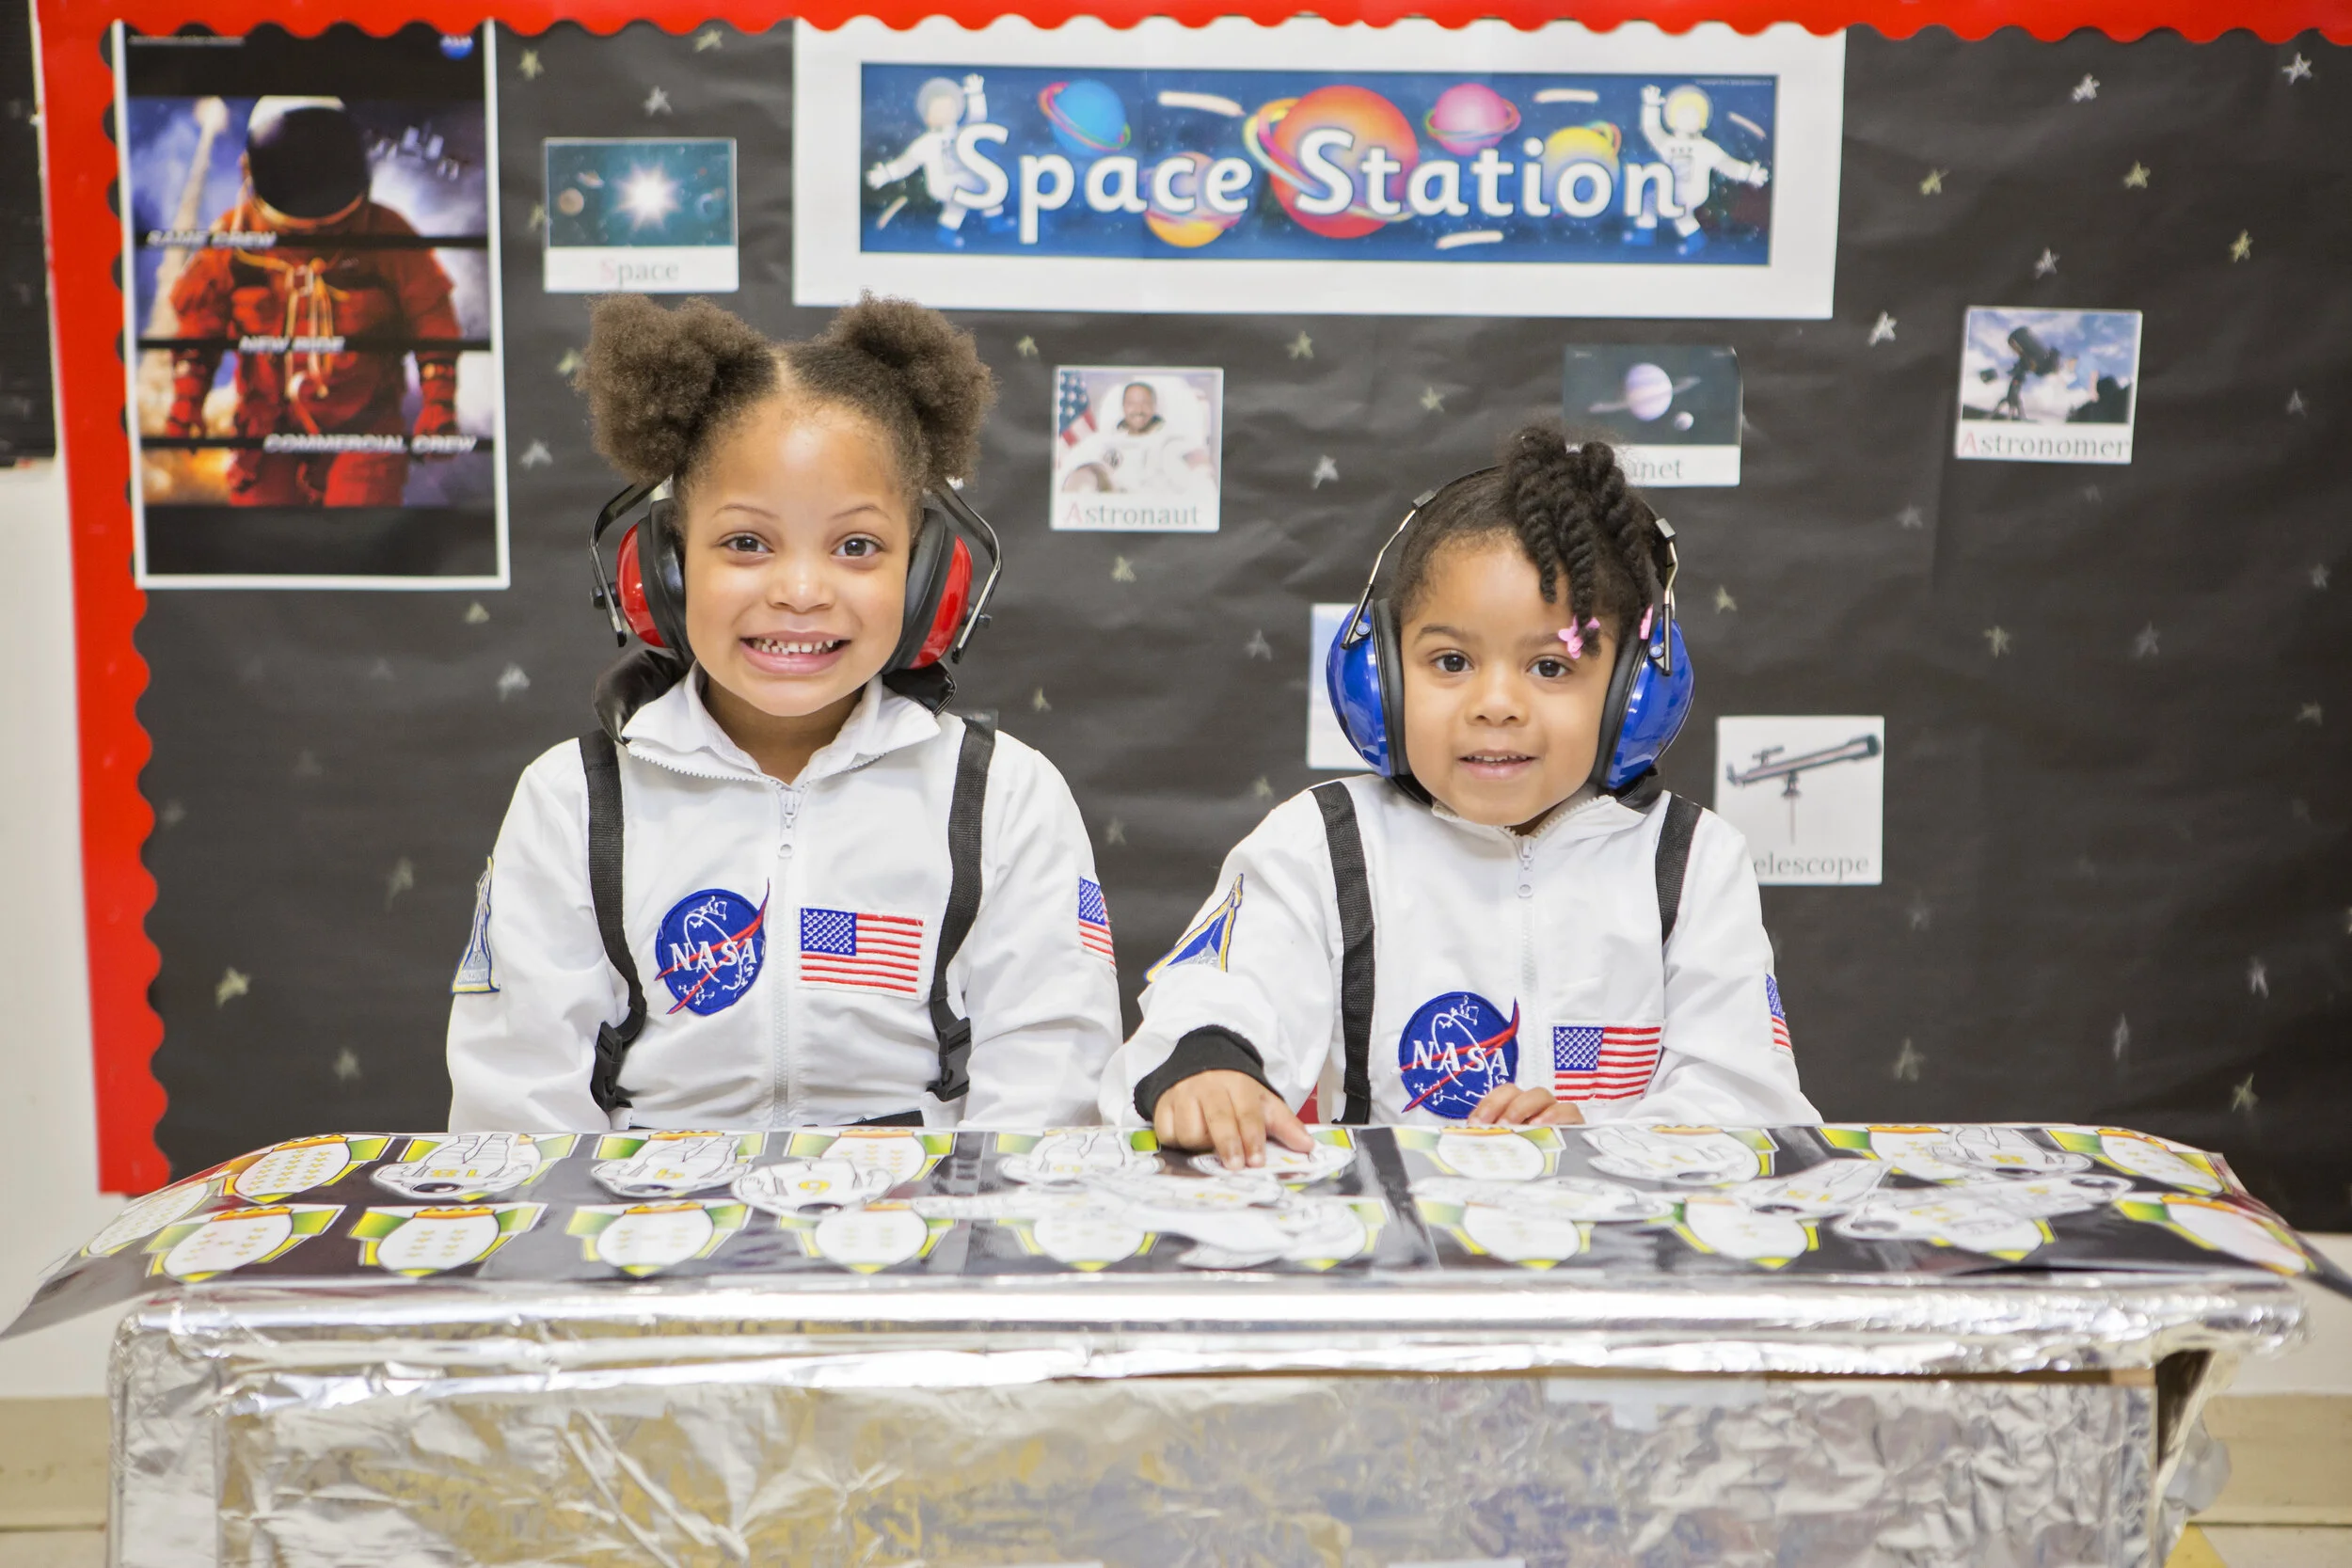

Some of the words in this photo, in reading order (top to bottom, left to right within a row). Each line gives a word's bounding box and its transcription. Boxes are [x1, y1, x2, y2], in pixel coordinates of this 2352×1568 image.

[954, 122, 1252, 245] Space
[1295, 128, 1685, 218] Station
[212, 231, 277, 248] CREW
[600, 258, 679, 287] Space
[239, 335, 291, 352] NEW
[263, 435, 407, 453] COMMERCIAL
[412, 435, 478, 453] CREW
[1961, 431, 2130, 457] Astronomer
[1064, 501, 1200, 526] Astronaut
[1753, 851, 1869, 880] elescope
[669, 937, 757, 973] NASA
[1411, 1039, 1509, 1077] NASA
